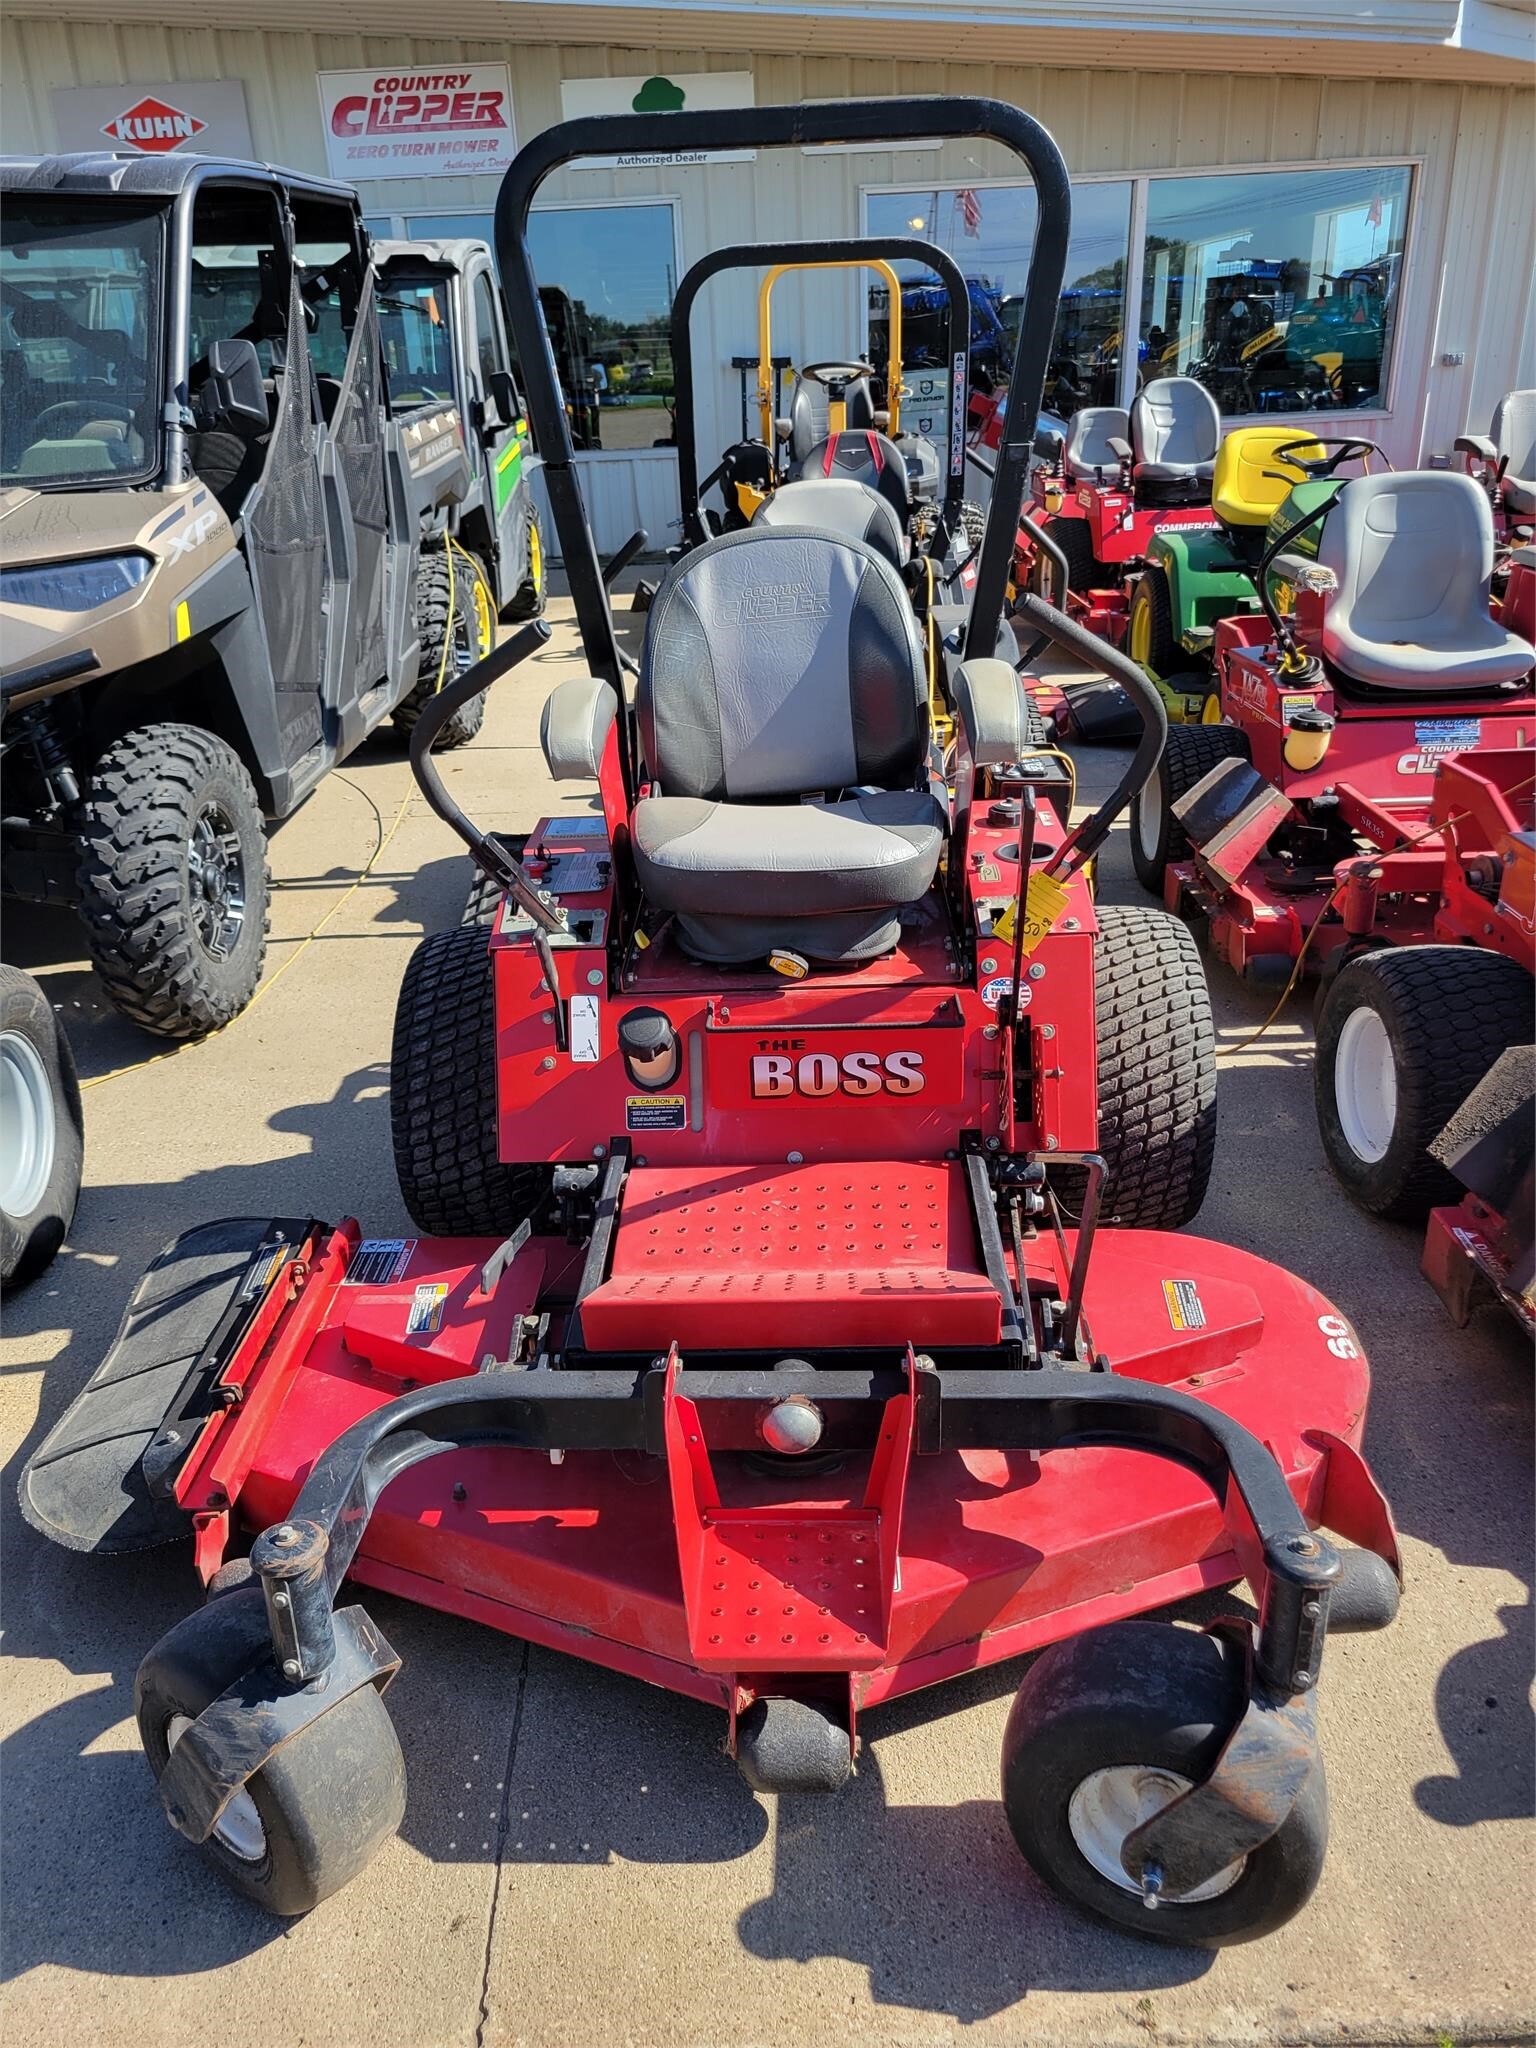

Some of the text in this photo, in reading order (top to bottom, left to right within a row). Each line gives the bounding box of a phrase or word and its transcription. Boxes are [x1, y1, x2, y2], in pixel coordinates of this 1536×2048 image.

[374, 74, 472, 93] COUNTRY
[331, 91, 508, 138] CLIPPER
[115, 115, 194, 140] KUHN
[346, 139, 500, 160] ZERO TURN MOWER
[617, 153, 708, 165] Authorized Dealer
[167, 509, 218, 568] XP
[741, 582, 809, 599] COUNTRY
[713, 591, 833, 629] CLIPPER
[1421, 745, 1475, 753] COUNTRY
[756, 1039, 806, 1051] THE
[752, 1051, 926, 1098] BOSS
[1317, 1314, 1359, 1360] 60
